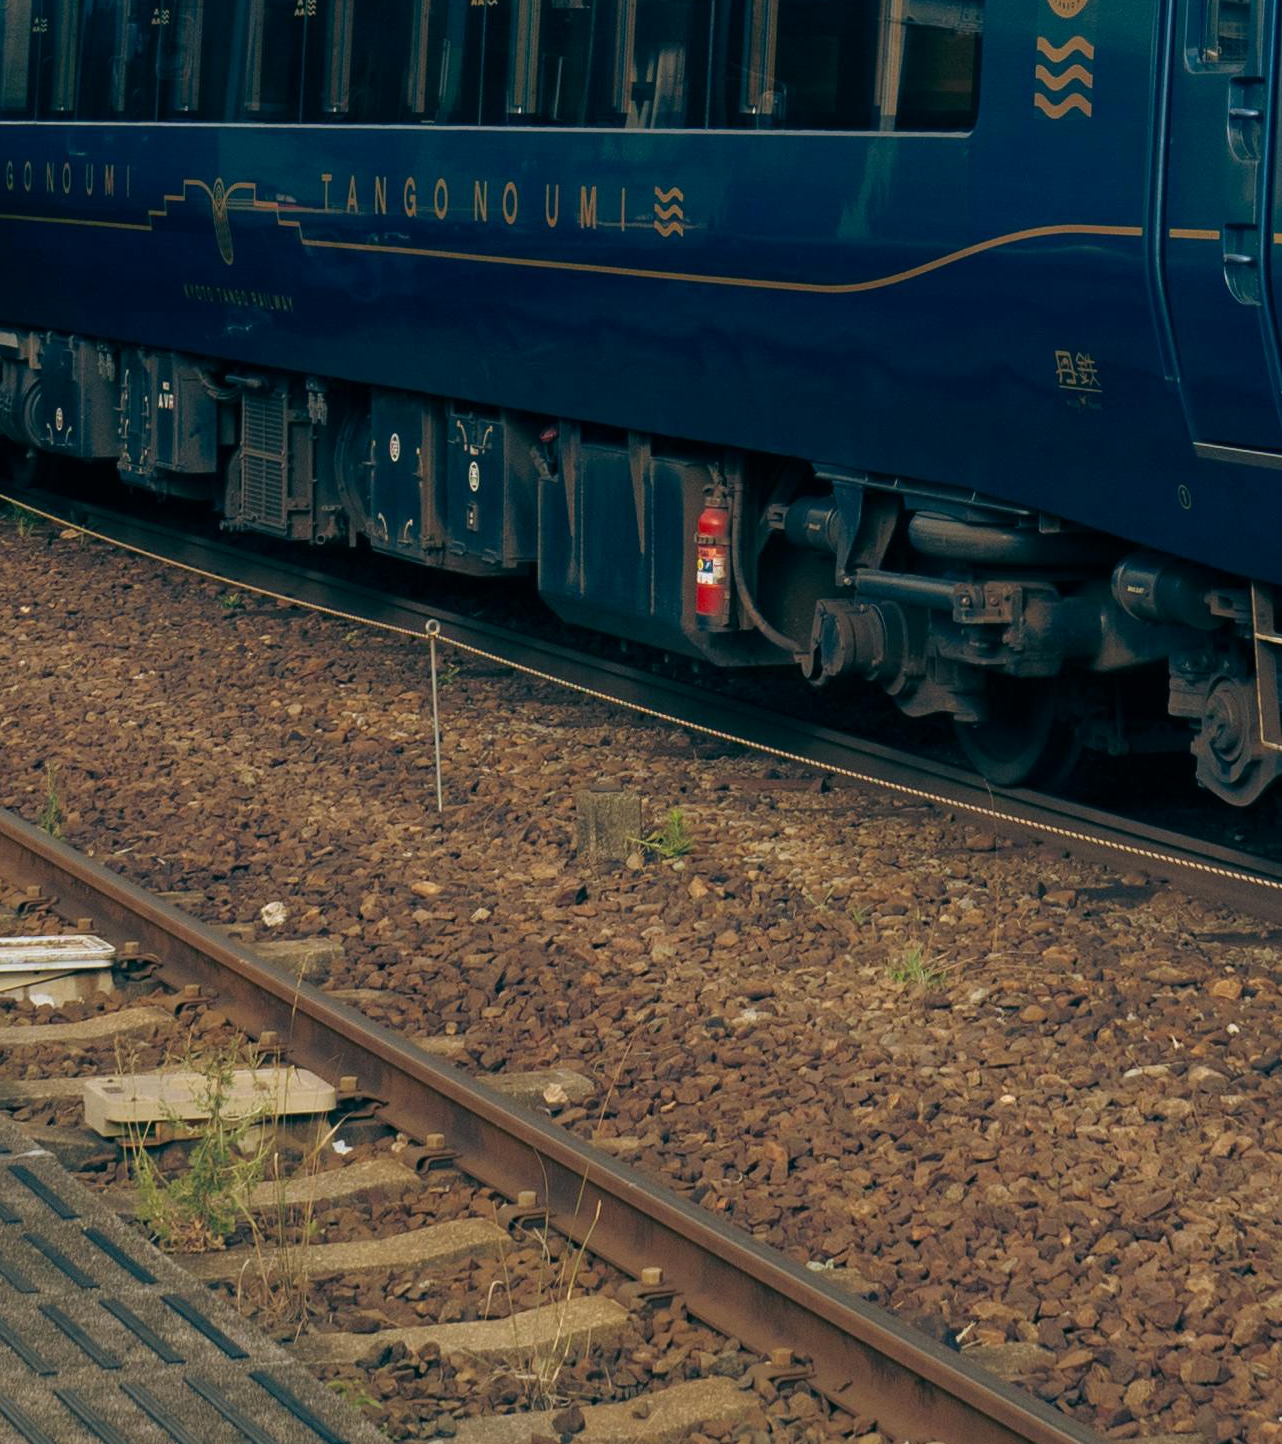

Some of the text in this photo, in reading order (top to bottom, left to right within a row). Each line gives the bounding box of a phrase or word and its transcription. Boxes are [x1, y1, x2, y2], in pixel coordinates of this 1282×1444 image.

[46, 161, 72, 195] NO
[86, 163, 130, 199] UMI
[321, 173, 625, 232] TANGO NO UMI
